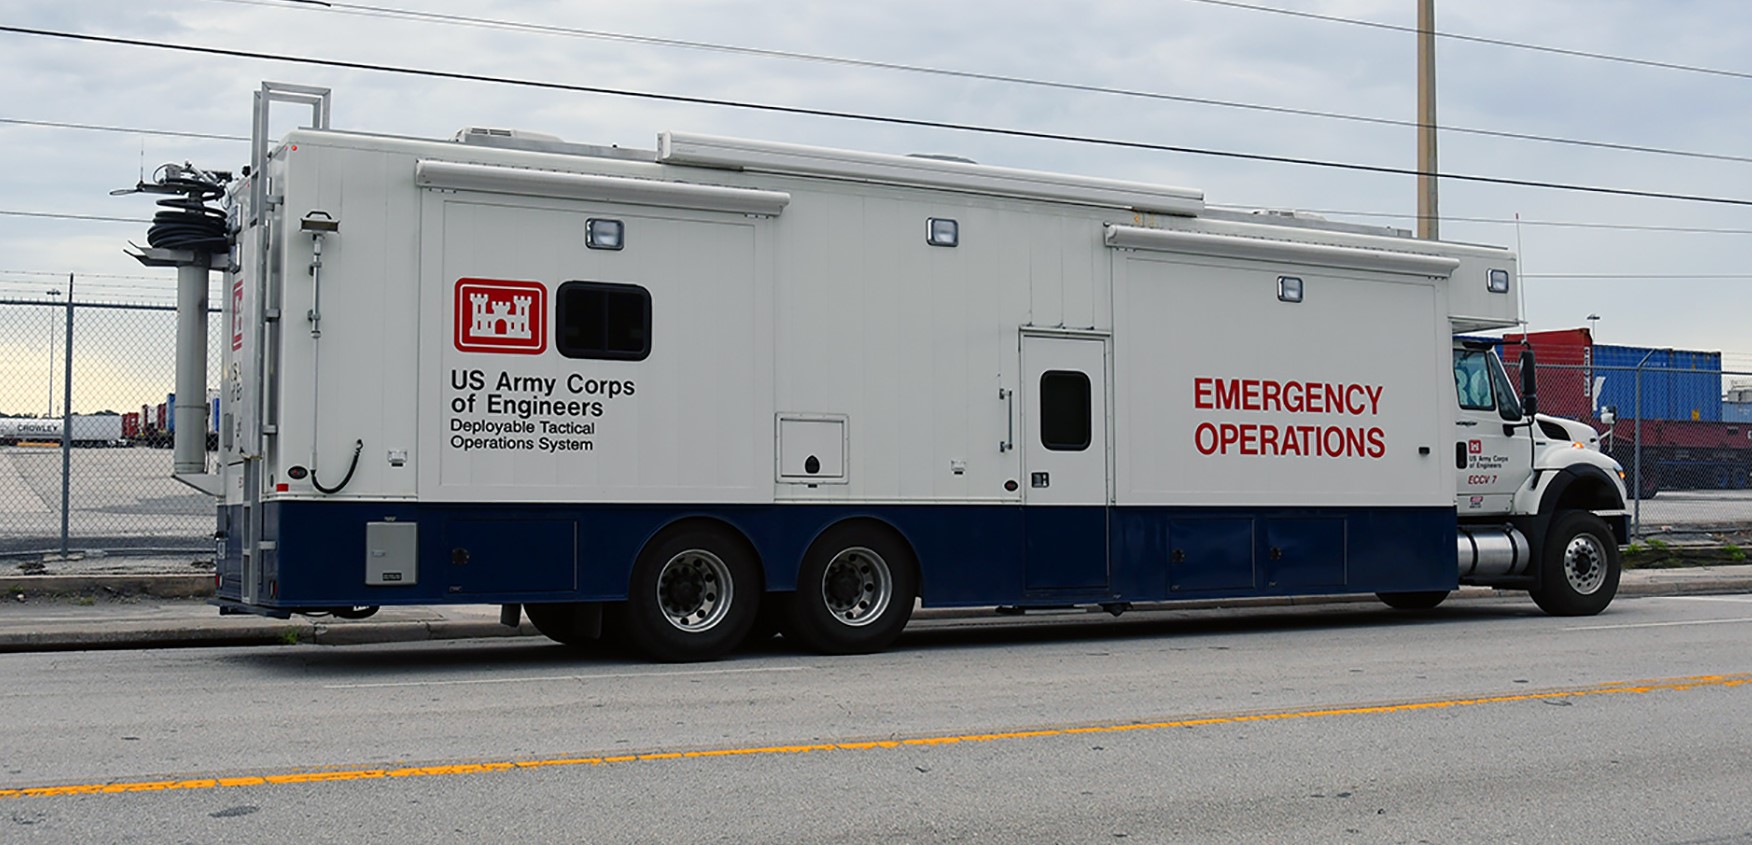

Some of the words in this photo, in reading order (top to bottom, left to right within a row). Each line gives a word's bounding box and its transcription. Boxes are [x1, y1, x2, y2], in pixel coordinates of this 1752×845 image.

[451, 369, 485, 391] US
[495, 371, 557, 397] Army
[566, 373, 636, 399] Corps
[1194, 377, 1384, 415] EMERGENCY
[451, 393, 476, 413] of
[487, 393, 604, 419] Engineers
[17, 424, 58, 432] CROWLEY
[450, 418, 535, 435] Deployable
[539, 420, 595, 435] Tactical
[450, 434, 534, 451] Operations
[538, 436, 594, 454] System
[1194, 422, 1386, 458] OPERATIONS
